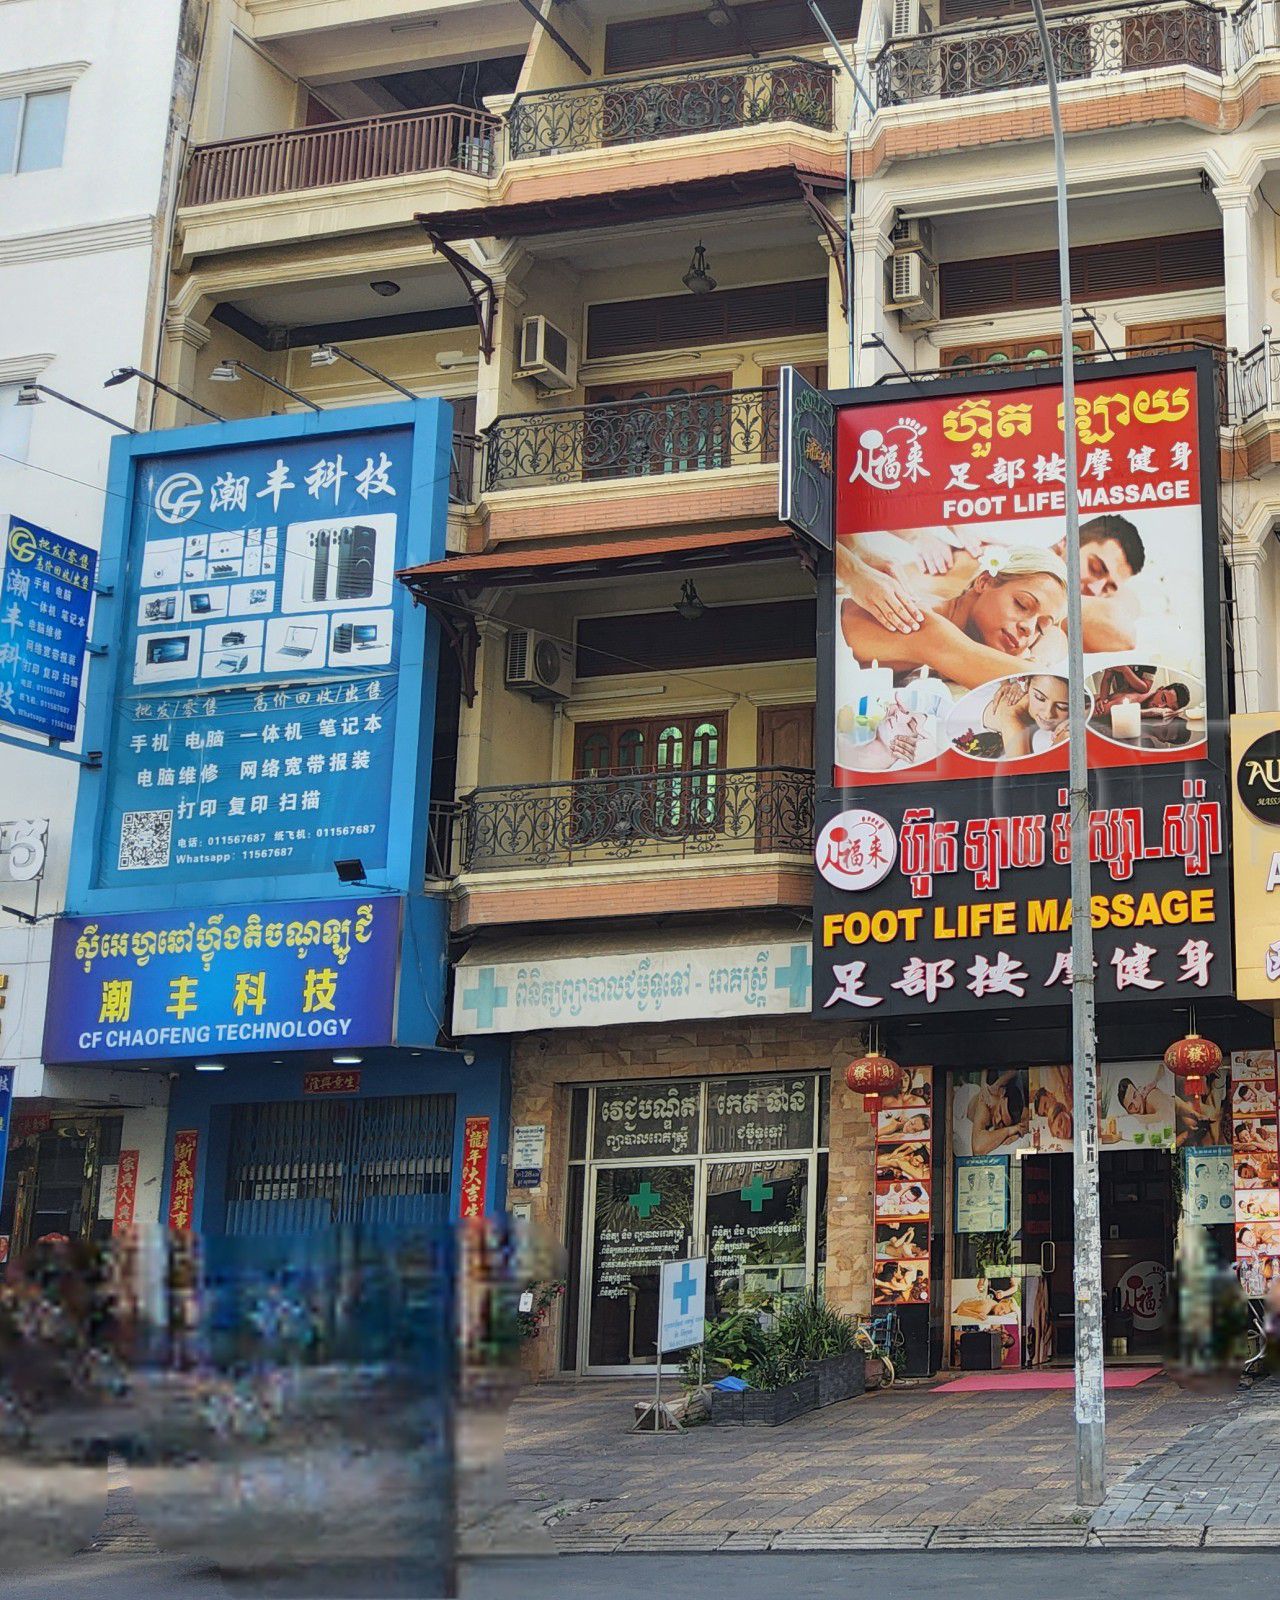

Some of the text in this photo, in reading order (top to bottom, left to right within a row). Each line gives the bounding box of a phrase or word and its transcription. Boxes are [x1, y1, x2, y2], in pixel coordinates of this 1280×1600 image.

[944, 441, 1192, 491] 足部按摩健身
[209, 453, 398, 514] 潮丰科技
[943, 480, 1190, 519] FOOT LIFE MASSAGE
[34, 577, 72, 602] 手机 电脑
[28, 619, 62, 640] 电脑维修
[61, 609, 86, 627] 笔记本
[62, 672, 79, 688] 扫描
[134, 680, 383, 719] 批发/零售 高价回收/出售
[130, 714, 383, 754] 手机 电脑 一体机 笔记本
[137, 751, 371, 787] 电脑维修 网络宽带报装
[177, 790, 321, 820] 打印 复印 扫描
[207, 833, 266, 846] 011567687
[316, 824, 376, 838] 011567687
[242, 847, 294, 860] 11567687
[823, 888, 1215, 947] FOOT LIFE MASSAGE
[98, 968, 338, 1023] 潮丰科技
[79, 1018, 352, 1049] CF CHAOFENG TECHNOLOGY
